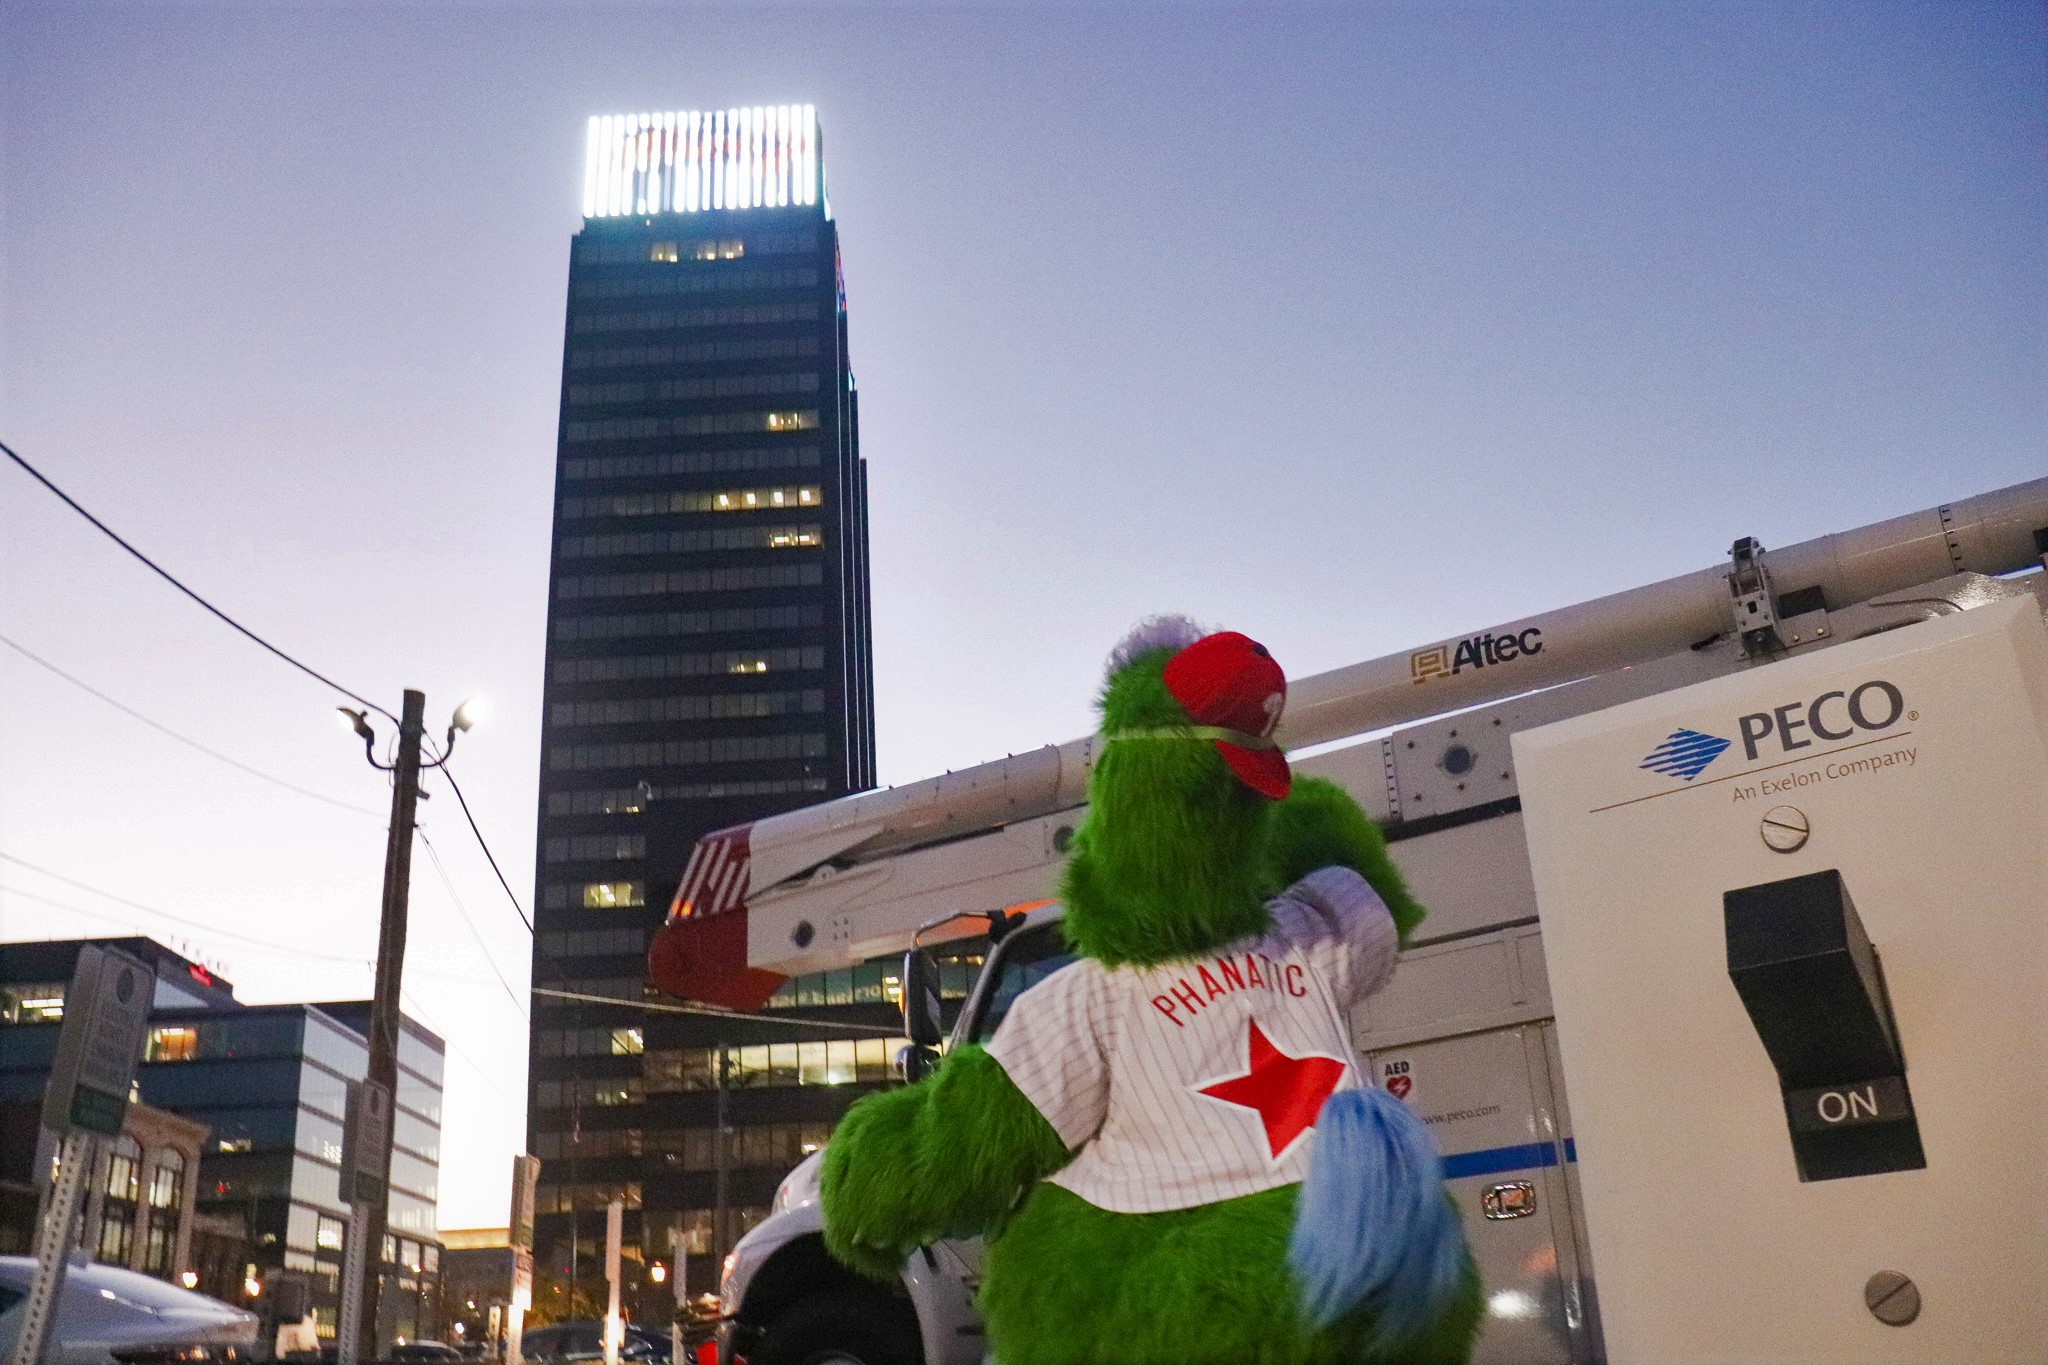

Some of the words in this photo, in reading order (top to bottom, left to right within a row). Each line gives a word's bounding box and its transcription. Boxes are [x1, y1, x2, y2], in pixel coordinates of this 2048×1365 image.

[1452, 627, 1543, 675] Altec
[1738, 680, 1904, 761] PECO
[1732, 786, 1756, 802] An
[1761, 772, 1821, 796] Exelon
[1826, 747, 1917, 780] Company
[1152, 952, 1307, 1028] PHANATIC
[1385, 1060, 1410, 1077] AED
[1423, 1105, 1501, 1125] ww.peco.com
[1818, 1086, 1879, 1122] ON
